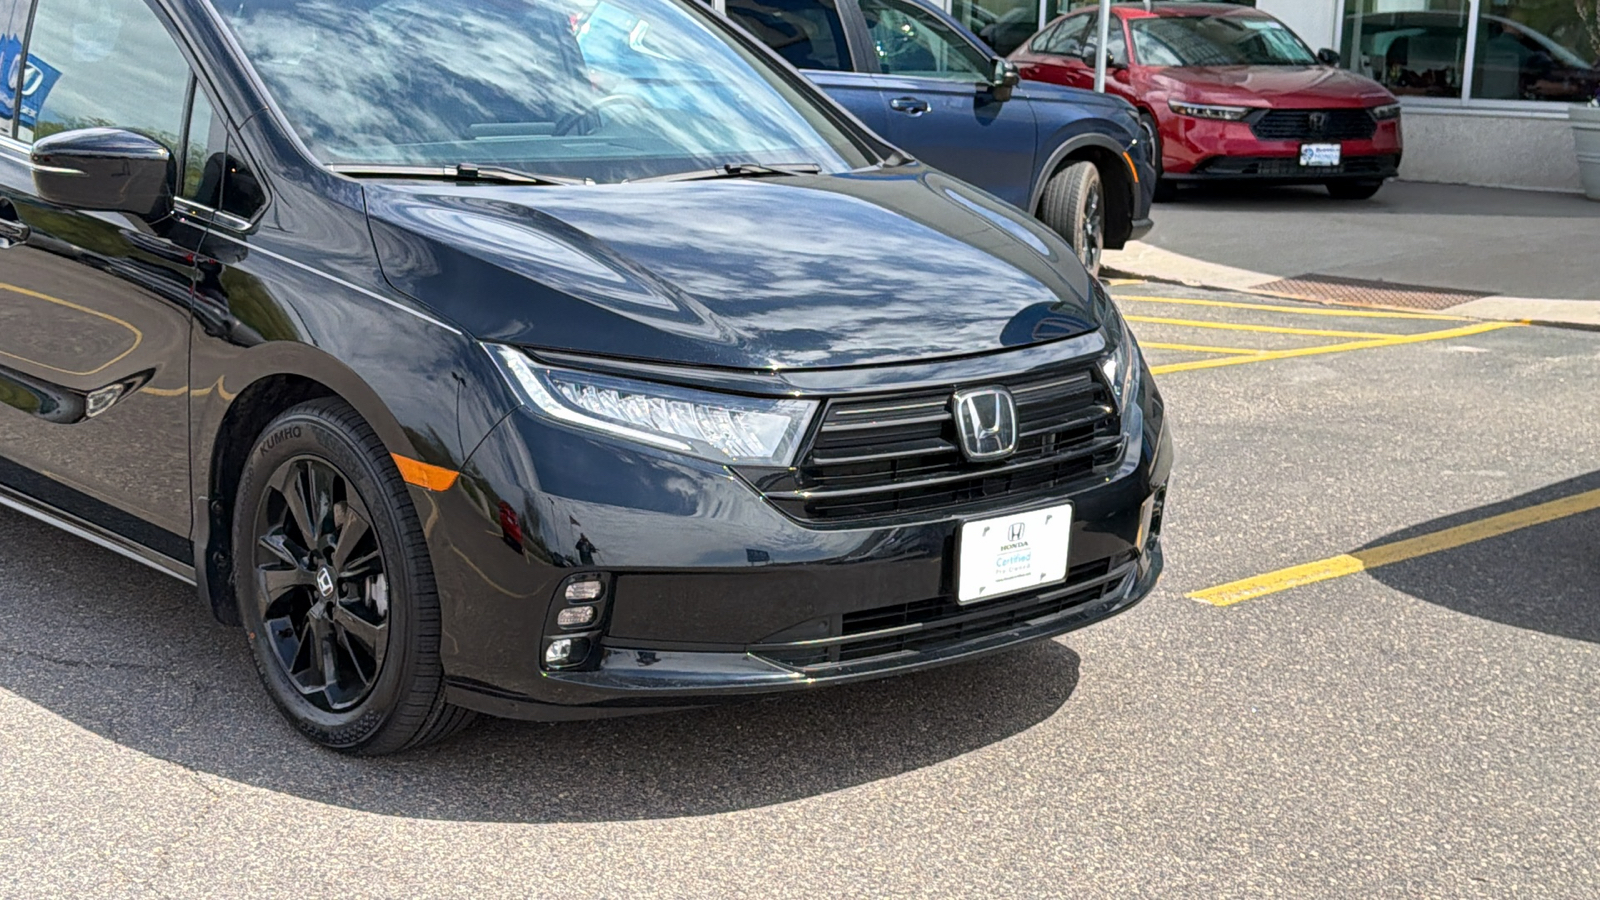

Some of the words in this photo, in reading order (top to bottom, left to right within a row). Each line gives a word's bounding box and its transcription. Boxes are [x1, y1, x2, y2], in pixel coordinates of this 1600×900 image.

[259, 426, 302, 457] KUMHO
[1000, 541, 1029, 551] HONDA
[996, 552, 1031, 567] Certified
